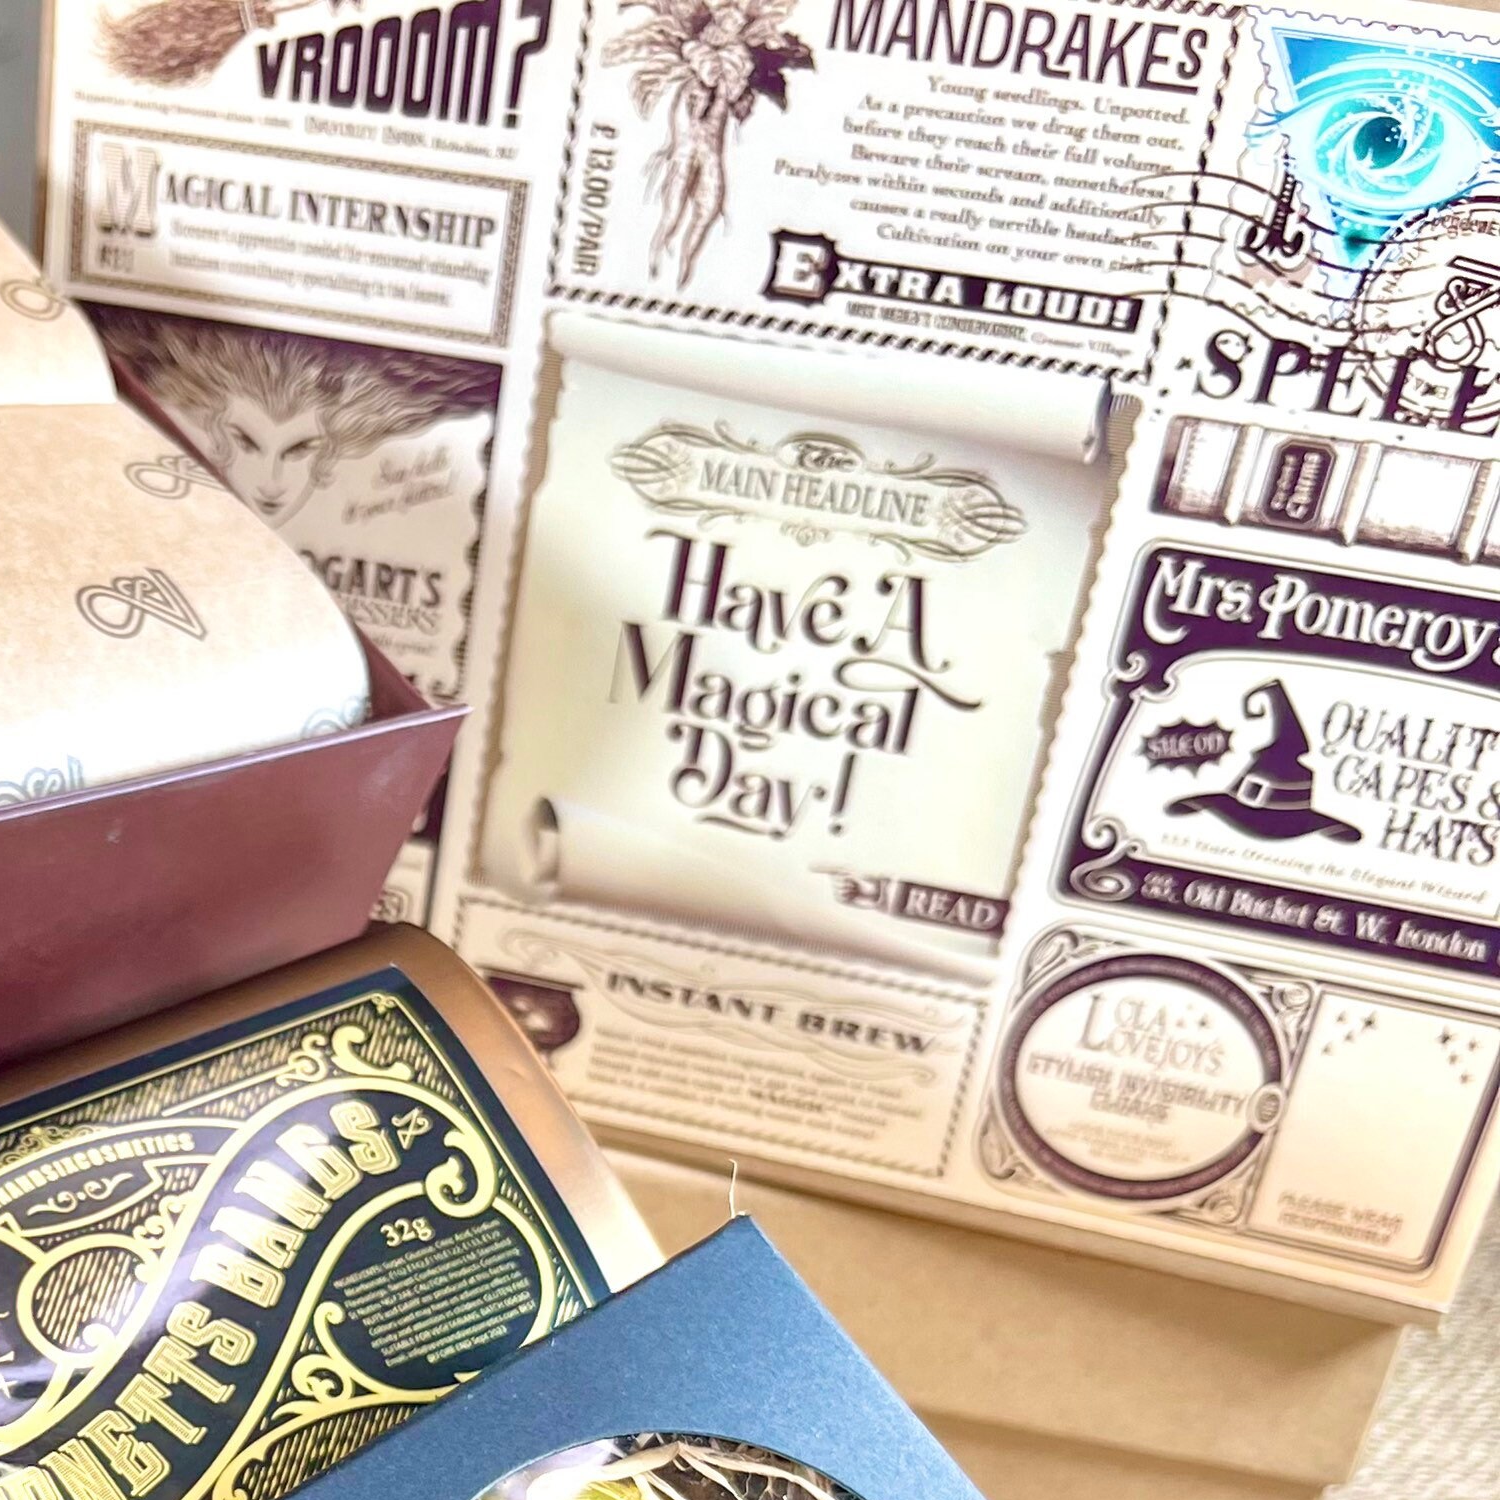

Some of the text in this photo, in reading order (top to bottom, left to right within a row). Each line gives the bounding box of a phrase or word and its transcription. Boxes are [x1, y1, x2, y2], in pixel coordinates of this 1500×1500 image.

[256, 0, 552, 129] VROOOM?
[825, 0, 1208, 93] MANDRAKES
[99, 141, 498, 250] MAGICAL INTERNSHIP
[773, 237, 1132, 328] EXTRA LOUD!
[699, 457, 931, 528] MAIN HEADLINE
[646, 528, 951, 673] Have A
[1257, 573, 1500, 672] Pomeroy
[610, 620, 984, 756] Magical
[666, 721, 858, 842] Day!
[1320, 699, 1500, 772] QUALIT
[1333, 754, 1472, 814] CAPES
[1380, 807, 1500, 867] HATS
[904, 882, 1000, 930] READ
[605, 969, 934, 1058] INSTANT BREW
[190, 1101, 401, 1309] BANDS
[380, 1216, 435, 1247] 32g
